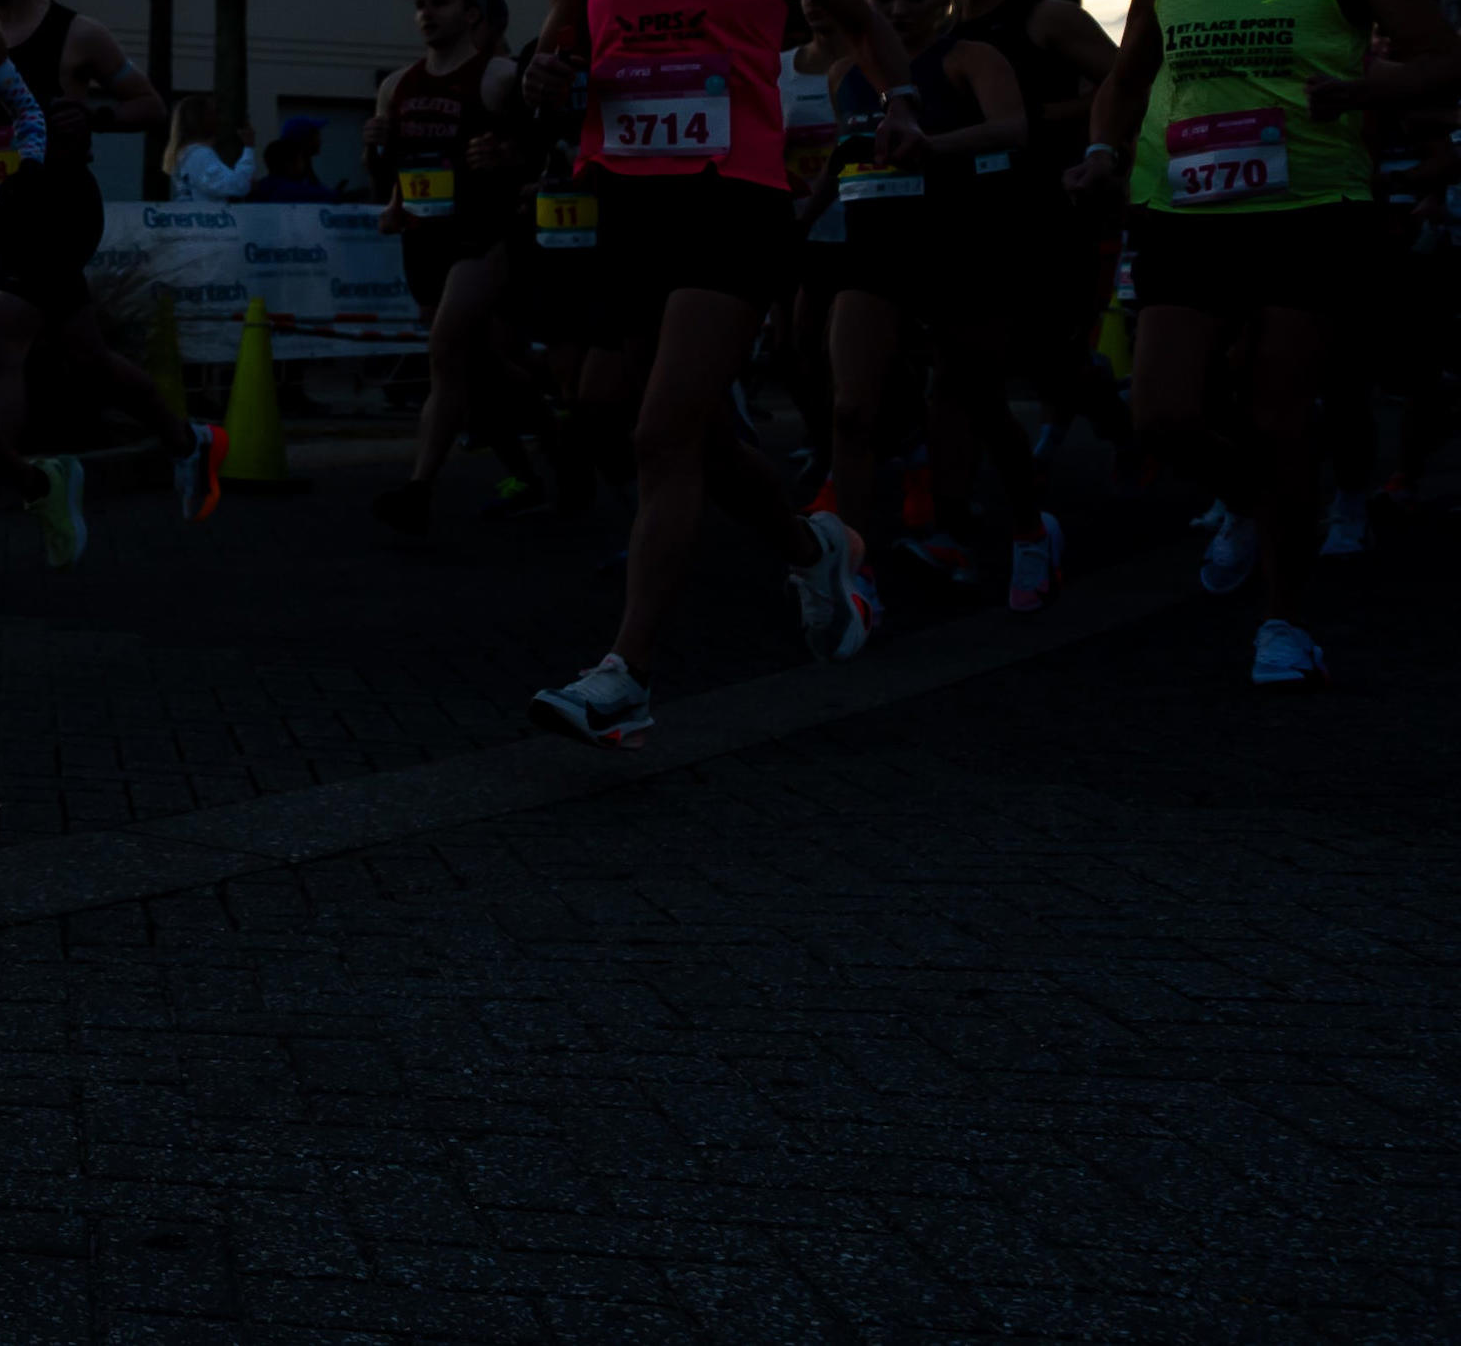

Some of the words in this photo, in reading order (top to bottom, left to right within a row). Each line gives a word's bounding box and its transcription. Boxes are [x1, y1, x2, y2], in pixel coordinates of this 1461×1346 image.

[1193, 19, 1237, 32] PLACE
[1240, 17, 1295, 30] SPORTS
[1179, 31, 1293, 49] RUNNING
[618, 112, 709, 145] 3714
[1181, 159, 1267, 194] 3770
[554, 205, 578, 225] 11
